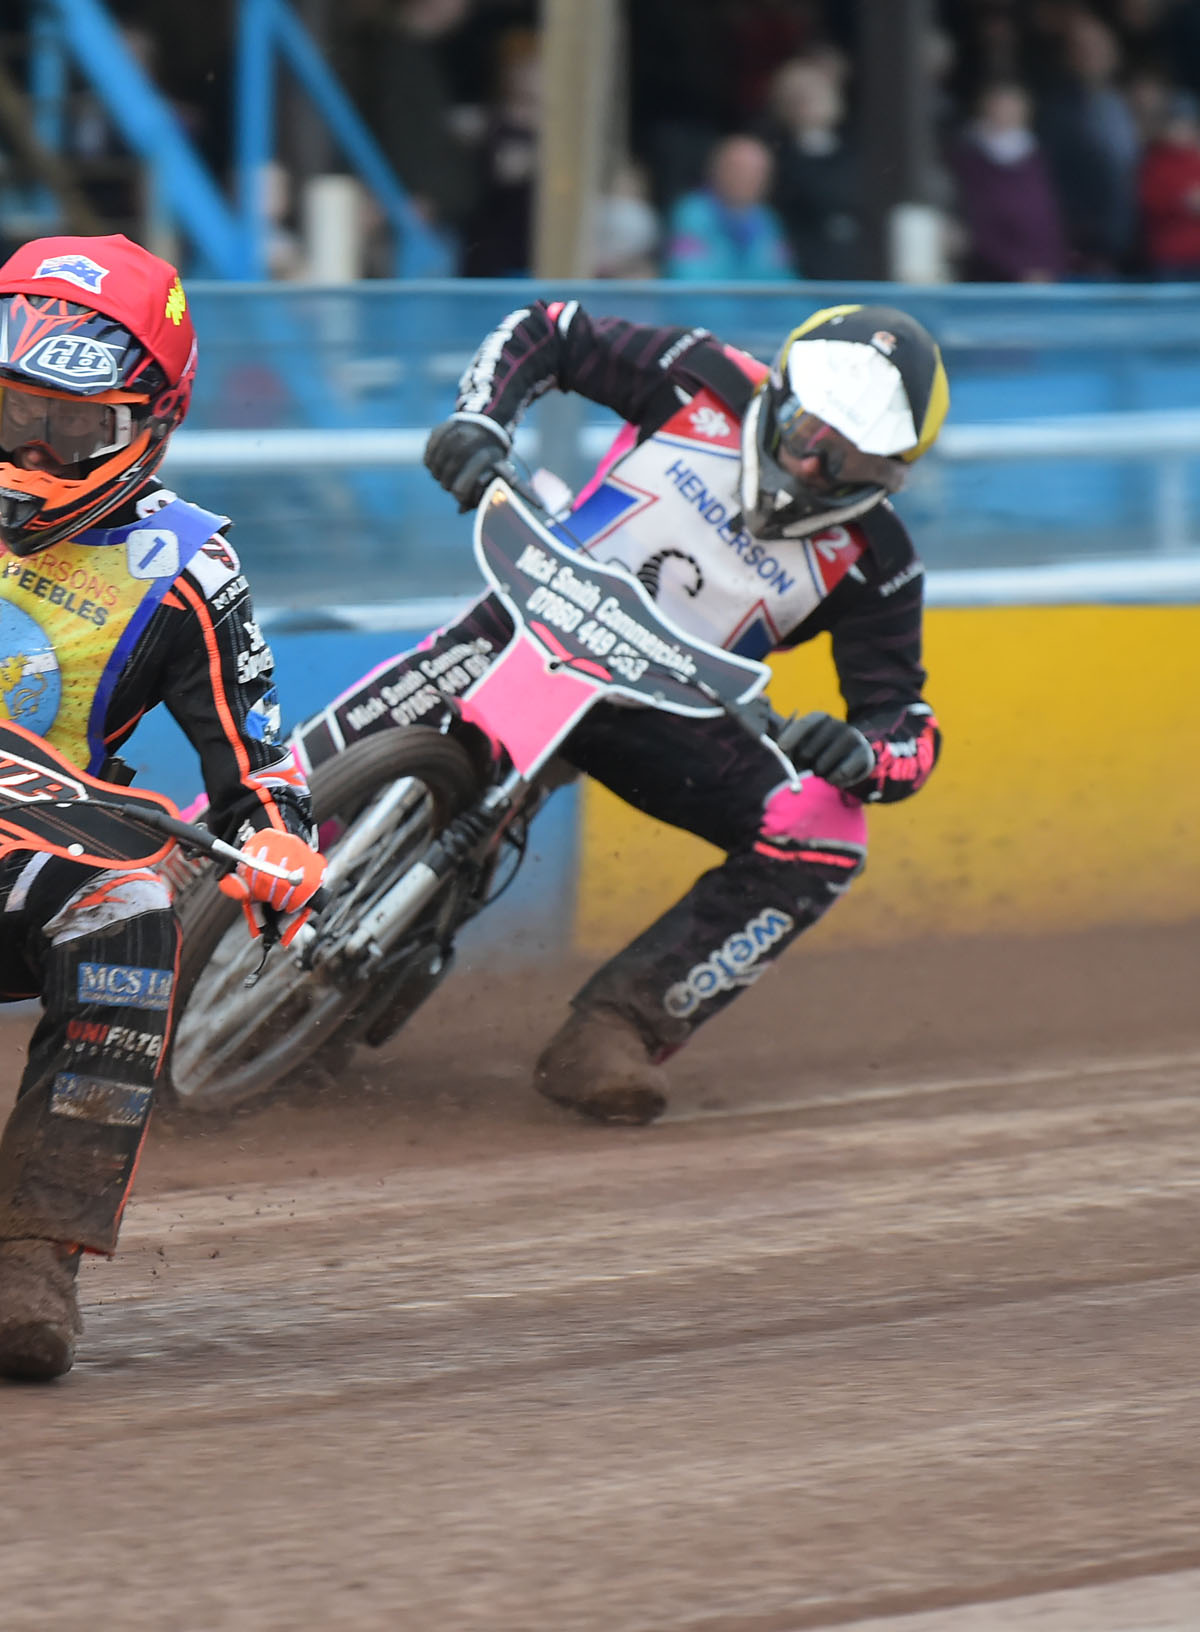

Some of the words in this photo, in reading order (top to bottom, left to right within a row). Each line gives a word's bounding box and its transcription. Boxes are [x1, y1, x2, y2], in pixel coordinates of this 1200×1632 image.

[665, 460, 796, 596] HENDERSON
[816, 526, 850, 563] 2
[139, 536, 167, 570] 1
[2, 562, 109, 626] PEEBLES
[20, 552, 121, 607] ARSONS
[81, 965, 144, 995] MCS
